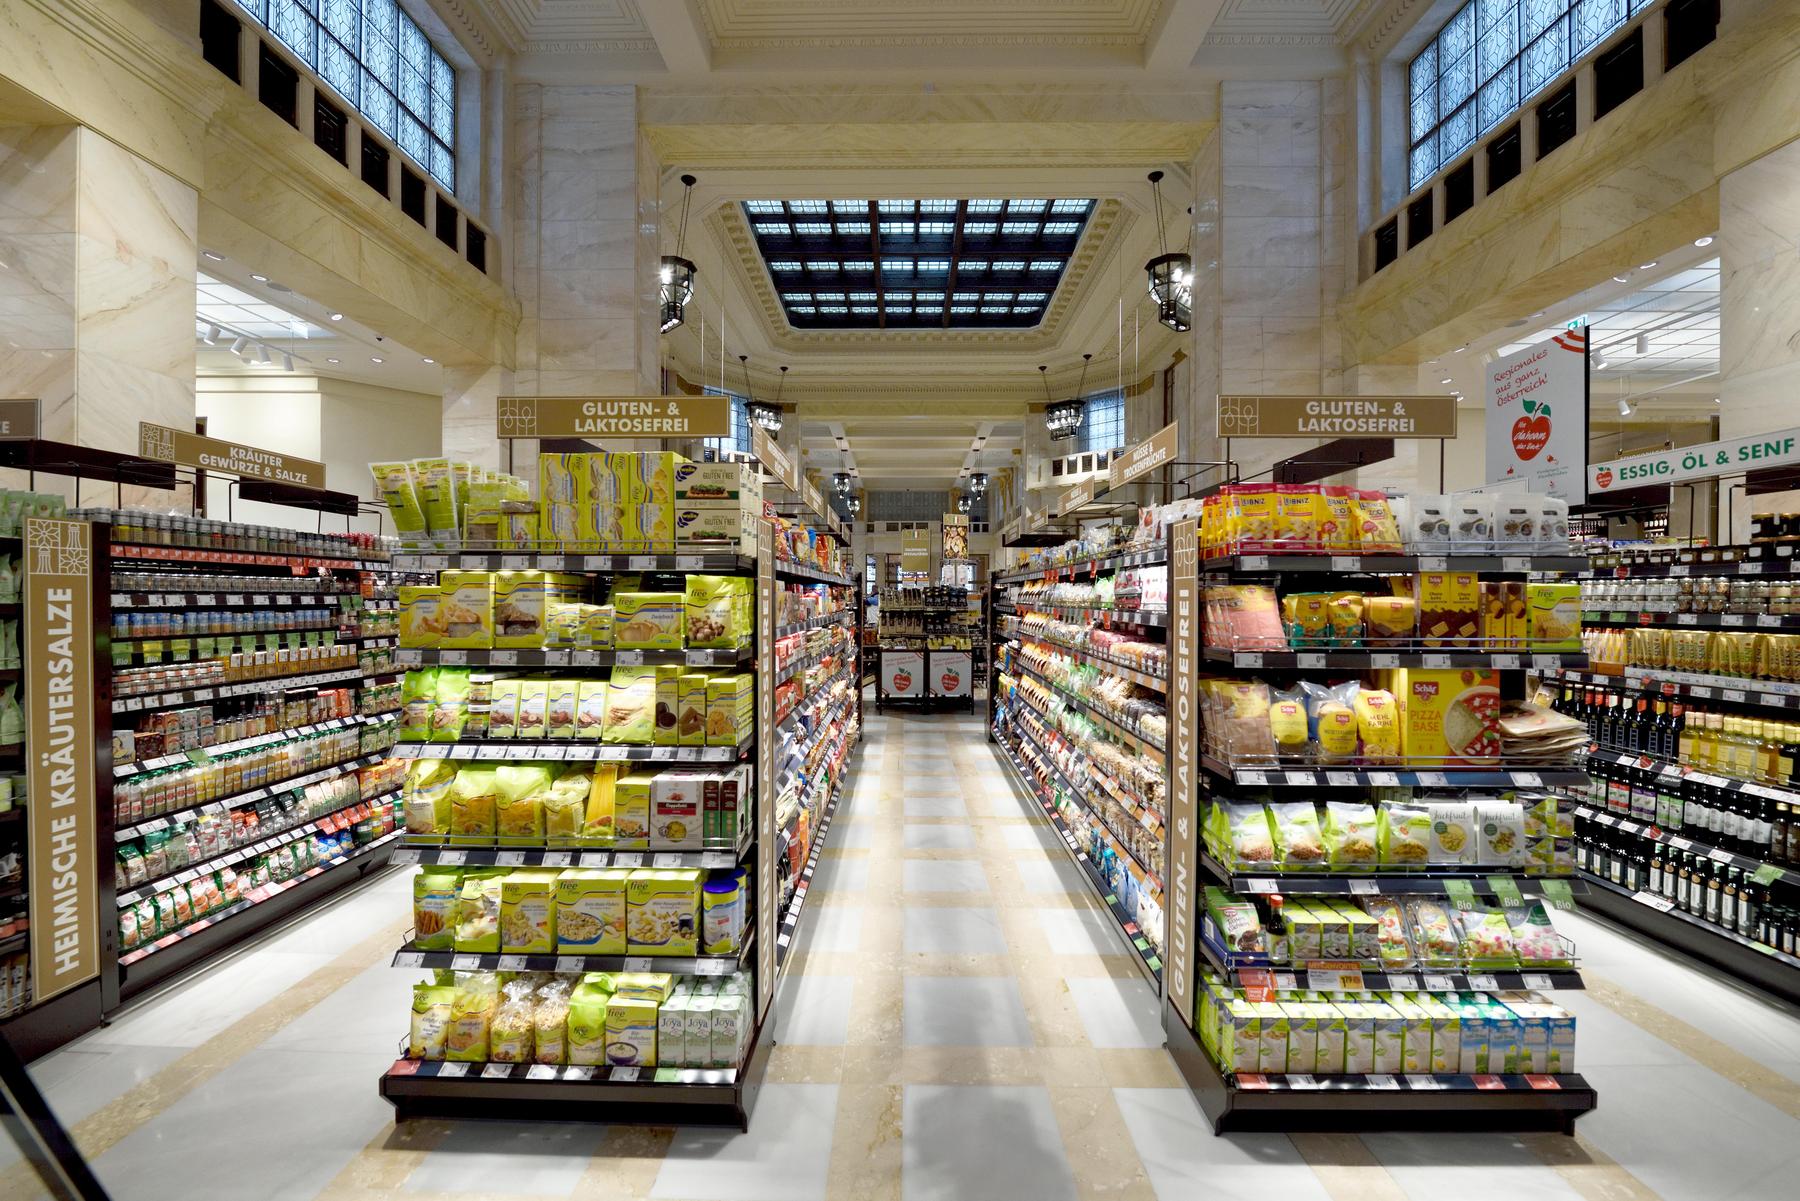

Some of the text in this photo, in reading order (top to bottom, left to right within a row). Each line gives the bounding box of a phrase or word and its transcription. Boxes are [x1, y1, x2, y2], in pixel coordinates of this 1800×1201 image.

[1493, 348, 1549, 384] Regionales
[1495, 367, 1540, 395] aus ganz
[1496, 373, 1549, 407] Österreich!
[582, 401, 681, 416] GLUTEN- &
[1306, 401, 1406, 416] GLUTEN- &
[574, 418, 690, 433] LAKTOSEFREI
[1298, 418, 1416, 433] LAKTOSEFREI
[230, 445, 283, 468] KRÄUTER
[1132, 443, 1149, 463] NÜSSE
[1619, 460, 1676, 481] ESSIG,
[1681, 451, 1708, 471] ÖL
[1715, 450, 1731, 465] &
[1738, 437, 1795, 461] SENF
[198, 450, 308, 485] GEWÜRZE & SALZE
[703, 472, 734, 480] GLUTEN FREE
[704, 518, 736, 526] GLUTEN FREE
[690, 588, 707, 597] free
[1536, 589, 1554, 599] free
[618, 597, 634, 606] free
[1414, 683, 1437, 694] Schär
[1410, 710, 1441, 721] PIZZA
[1412, 721, 1440, 732] BASE
[42, 587, 80, 977] HEIMISCHE KRÄUTERSALZE
[1174, 589, 1190, 997] GLUTEN- & LAKTOSEFREI
[504, 885, 520, 893] free
[560, 881, 578, 891] free
[630, 881, 649, 891] free
[1456, 900, 1473, 910] Bio
[1503, 897, 1520, 907] Bio
[1555, 900, 1572, 910] Bio
[608, 1008, 626, 1018] free
[660, 1017, 682, 1029] Joya
[688, 1018, 708, 1029] Joya
[714, 1017, 735, 1029] Joya
